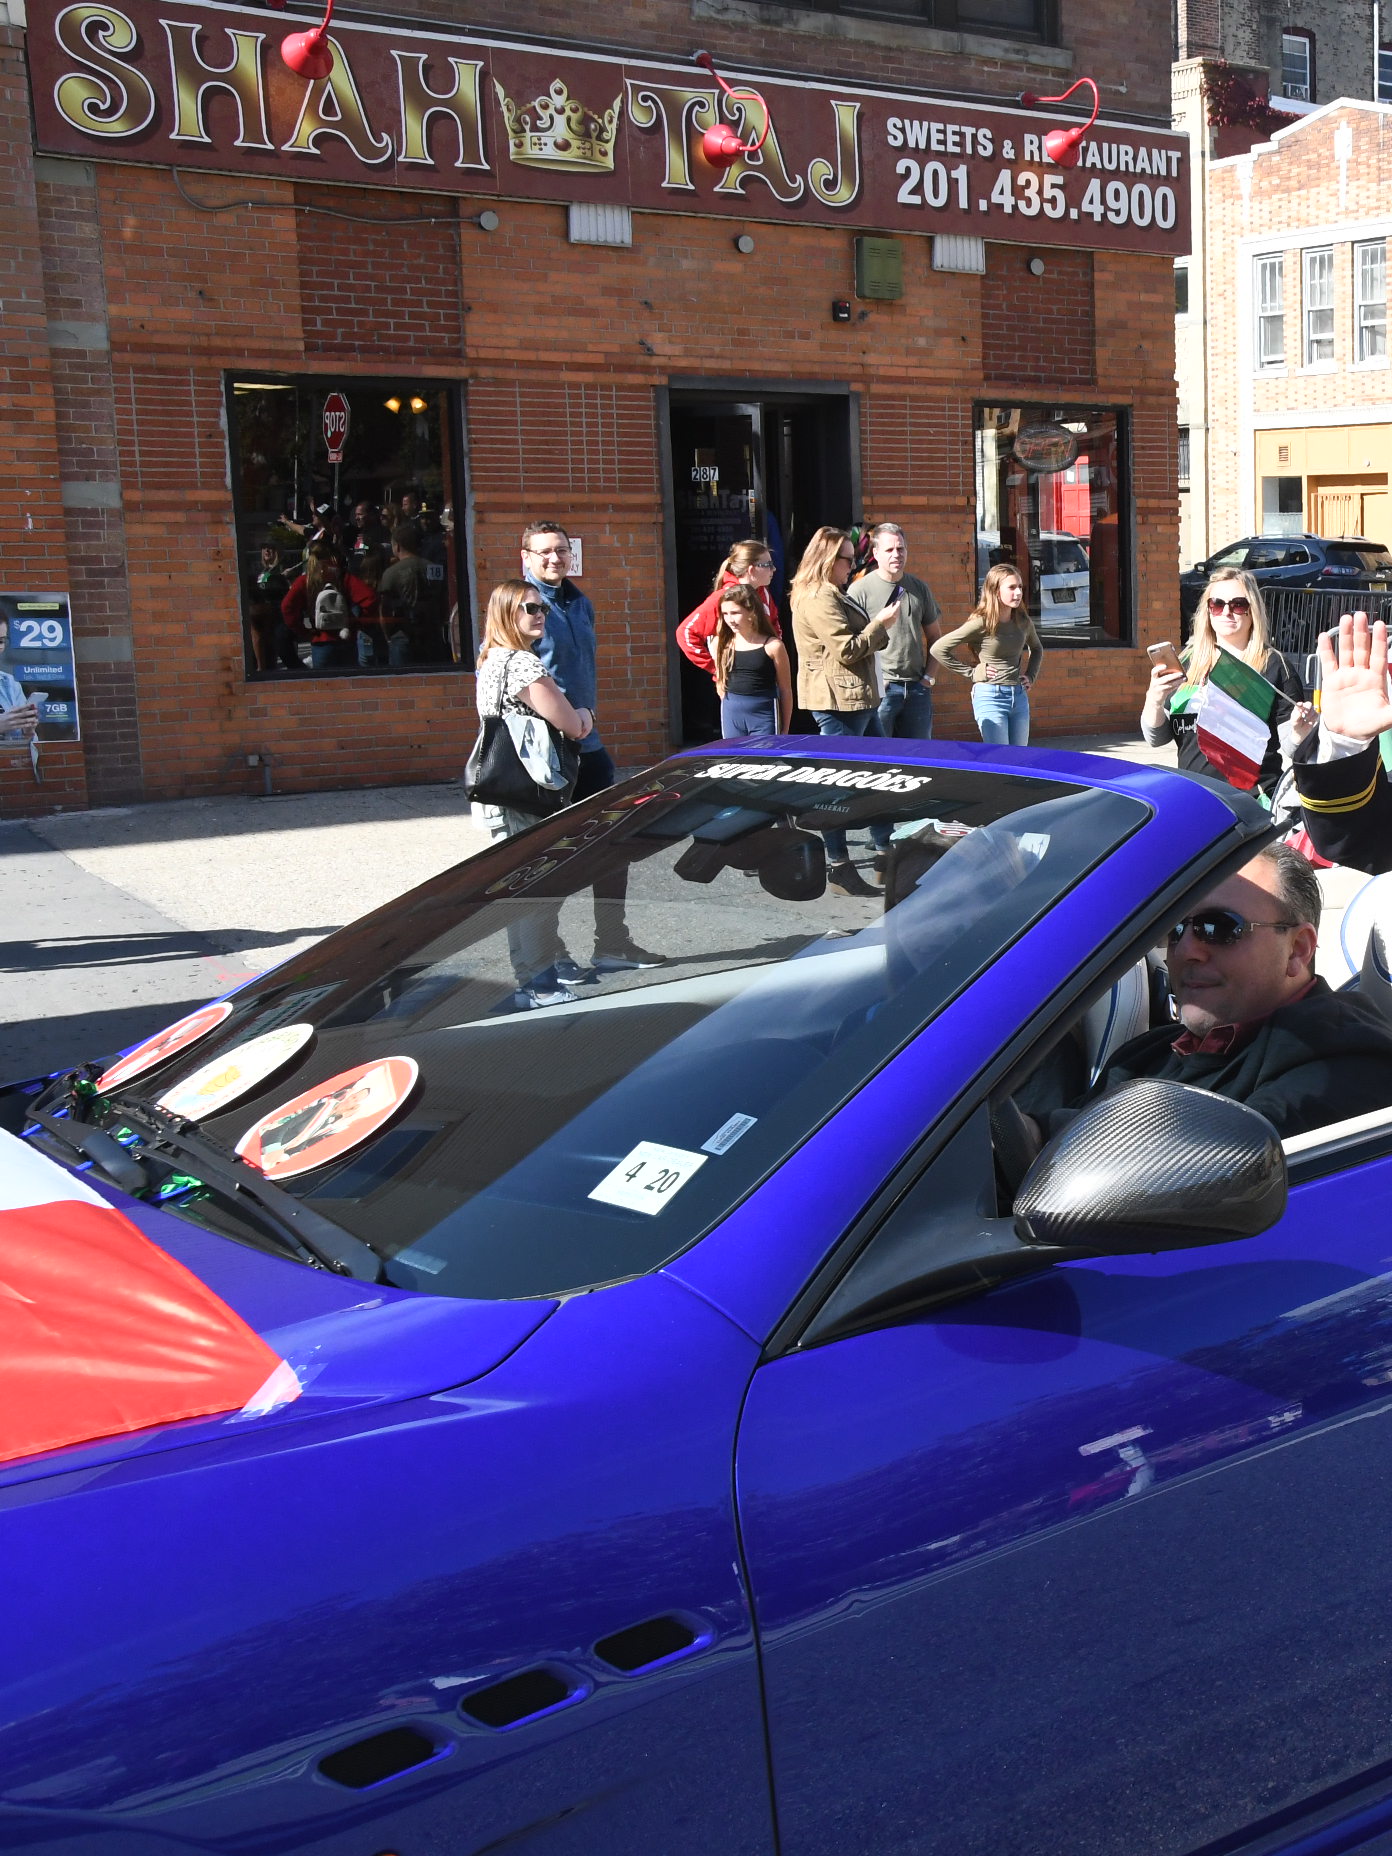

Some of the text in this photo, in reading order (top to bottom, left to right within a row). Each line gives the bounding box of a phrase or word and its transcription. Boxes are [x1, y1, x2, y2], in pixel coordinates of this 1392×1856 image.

[54, 2, 862, 207] SHAH TAJ
[886, 117, 1182, 178] SWEETS & RTAURANT
[895, 158, 1177, 230] 201.435.4900
[692, 468, 717, 480] 287
[13, 620, 64, 647] $29
[45, 704, 68, 712] 7GB
[694, 763, 933, 793] SUPER DRAGÕES
[813, 803, 850, 813] MASERATI
[624, 1161, 648, 1183] 4
[643, 1168, 680, 1194] 20
